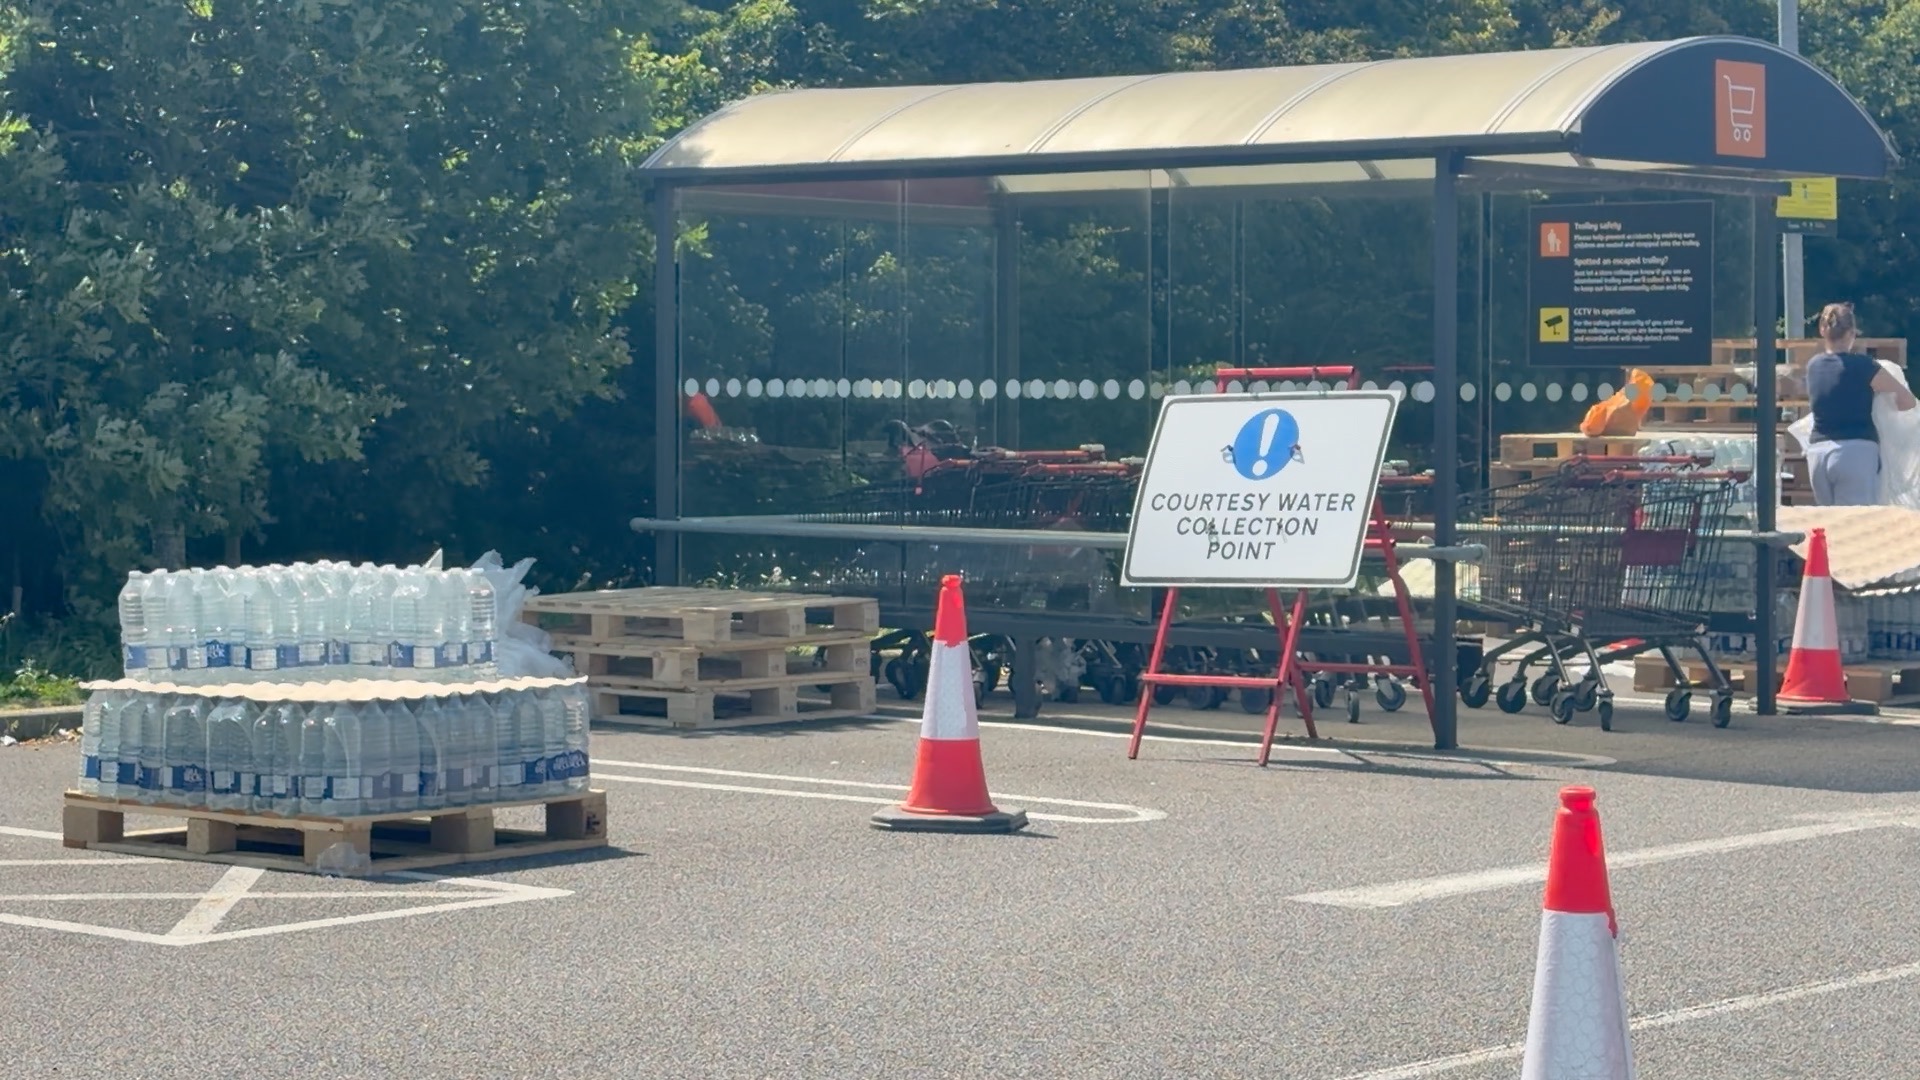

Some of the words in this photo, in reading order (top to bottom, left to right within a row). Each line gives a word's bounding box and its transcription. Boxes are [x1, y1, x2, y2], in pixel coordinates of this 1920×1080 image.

[1574, 221, 1599, 231] Trolley
[1599, 220, 1622, 231] safety
[1574, 257, 1601, 267] Spotted
[1612, 256, 1641, 266] escaped
[1642, 255, 1669, 266] trolley?
[1573, 307, 1592, 316] CCTV
[1592, 307, 1601, 316] in
[1601, 307, 1636, 317] operation
[1150, 492, 1271, 512] COURTESY
[1278, 492, 1356, 512] WATER
[1176, 516, 1319, 536] COLLECTION
[1206, 541, 1276, 561] POINT
